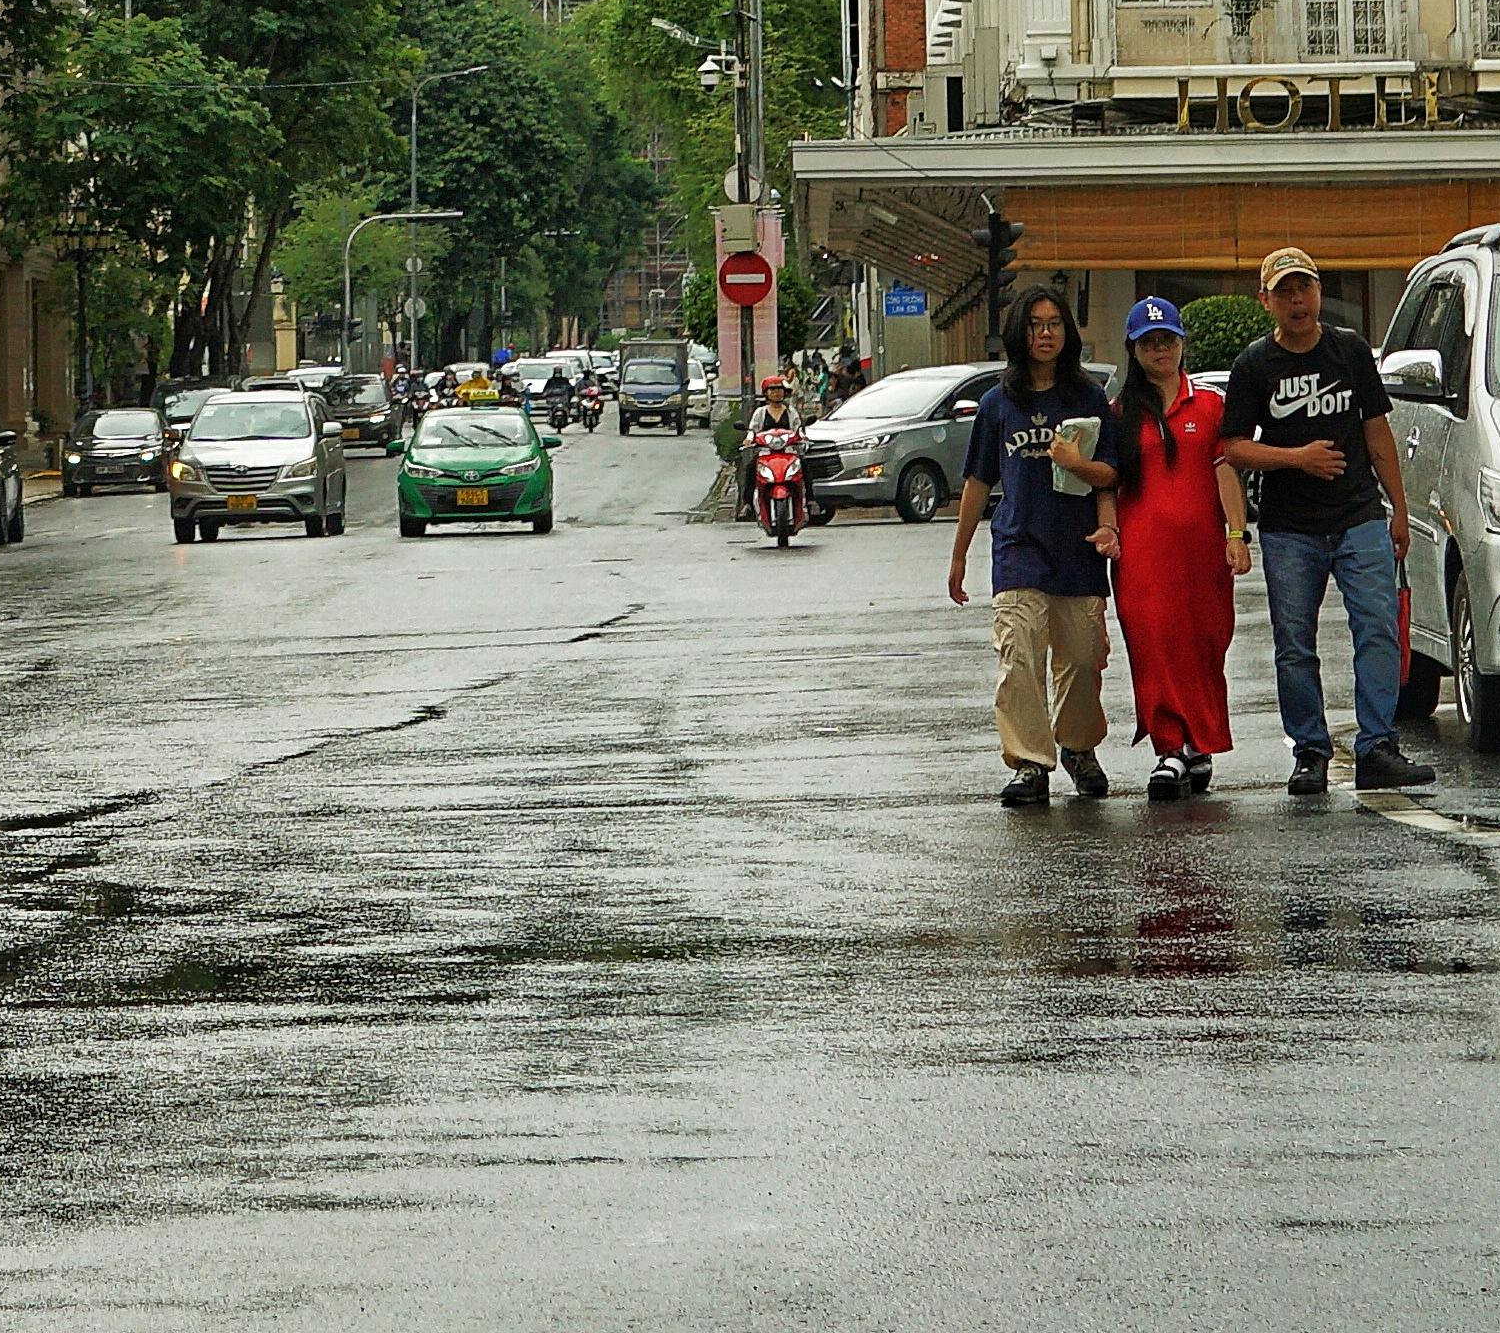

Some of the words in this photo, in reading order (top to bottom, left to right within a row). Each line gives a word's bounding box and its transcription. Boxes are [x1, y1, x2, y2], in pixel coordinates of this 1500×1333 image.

[1175, 71, 1464, 133] HOTEL
[1146, 303, 1164, 320] LA
[1276, 373, 1321, 401] JUST
[1003, 427, 1055, 458] ADID
